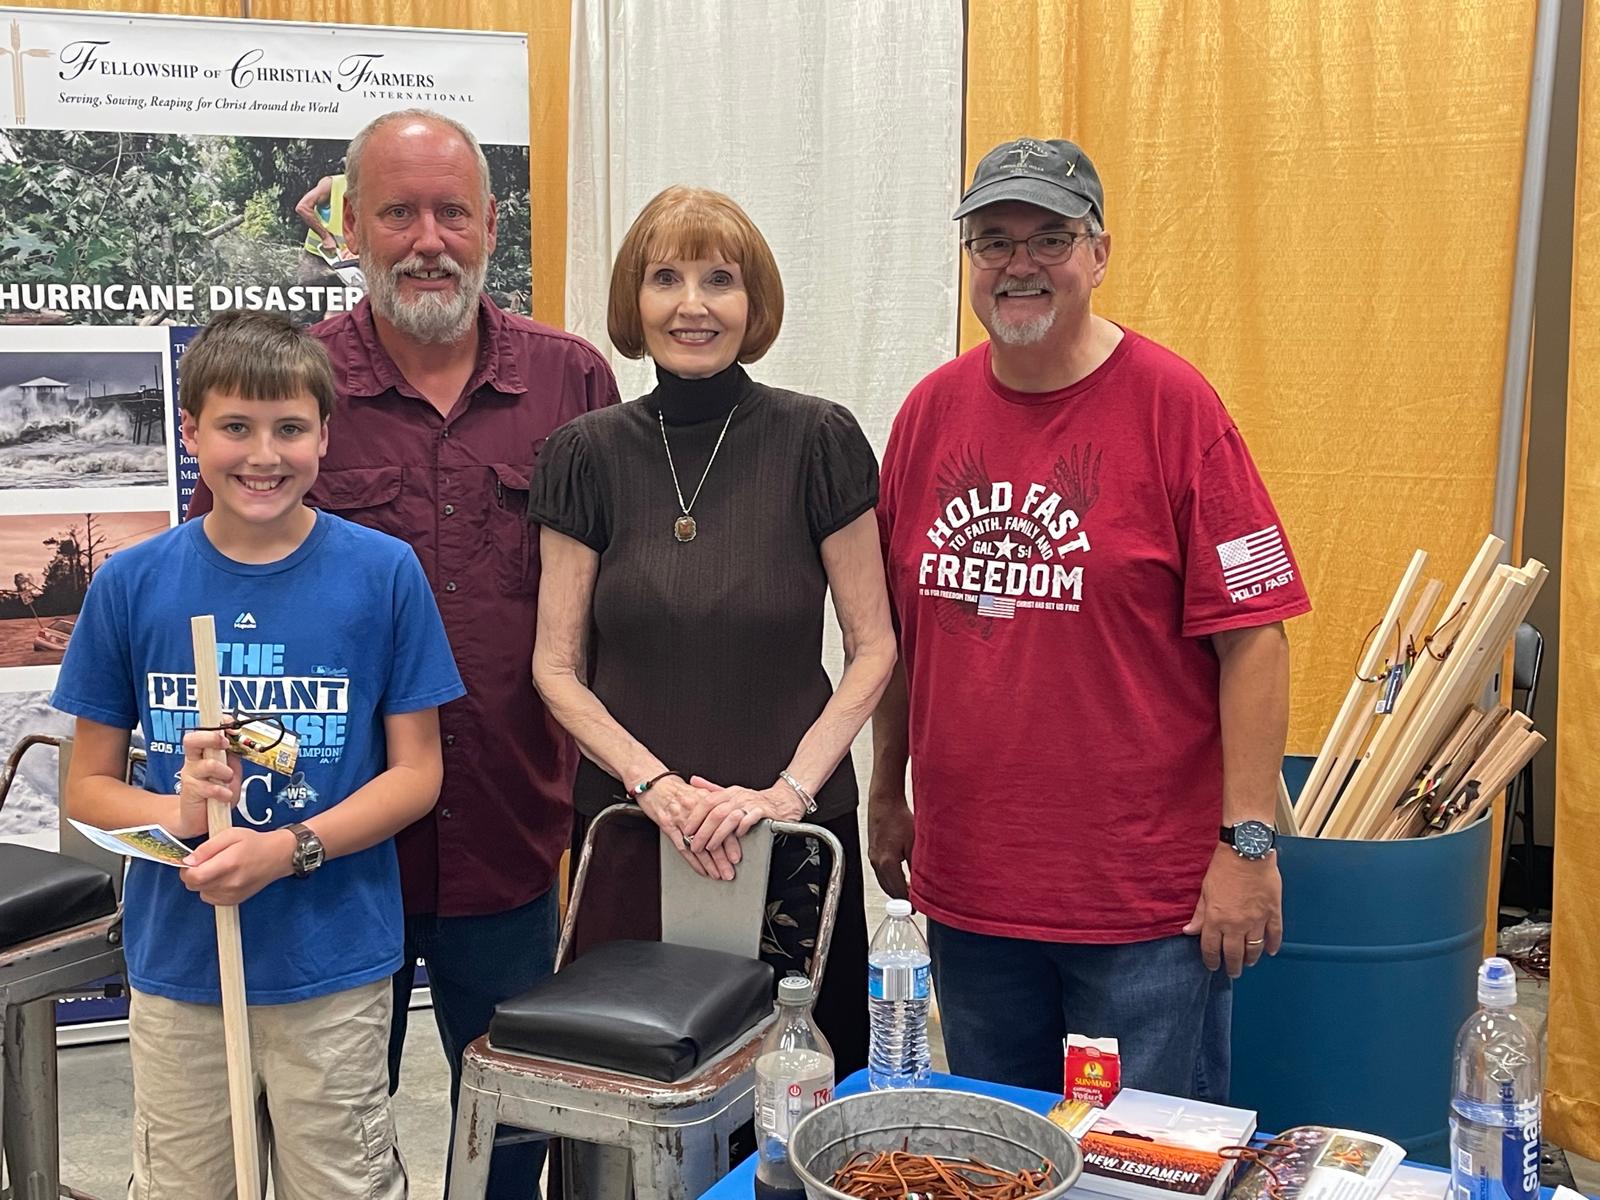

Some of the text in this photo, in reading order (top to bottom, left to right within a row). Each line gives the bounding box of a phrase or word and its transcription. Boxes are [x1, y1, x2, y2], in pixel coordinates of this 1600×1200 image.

[58, 41, 435, 92] FELLOWSHIP OF CHRISTIAN FARMERS
[58, 92, 339, 114] Serving, Sowing, Reaping for Christ Around the World
[363, 90, 474, 103] INTERNATIONAL
[0, 283, 364, 311] HURRICANE DISASTER
[173, 343, 188, 353] Th
[180, 455, 198, 464] Jon
[926, 481, 1091, 558] HOLD FAST
[948, 534, 966, 552] TO
[1005, 516, 1042, 541] FAMILY
[1034, 535, 1054, 561] AND
[1017, 544, 1032, 559] 5:1
[918, 552, 1085, 600] FREEDOM
[1229, 570, 1294, 604] HOLD FAST
[153, 676, 345, 710] PENANT
[287, 787, 307, 800] WS
[1519, 1095, 1539, 1193] smart
[1084, 1152, 1120, 1168] NEW
[1120, 1160, 1201, 1184] TESTAMENT
